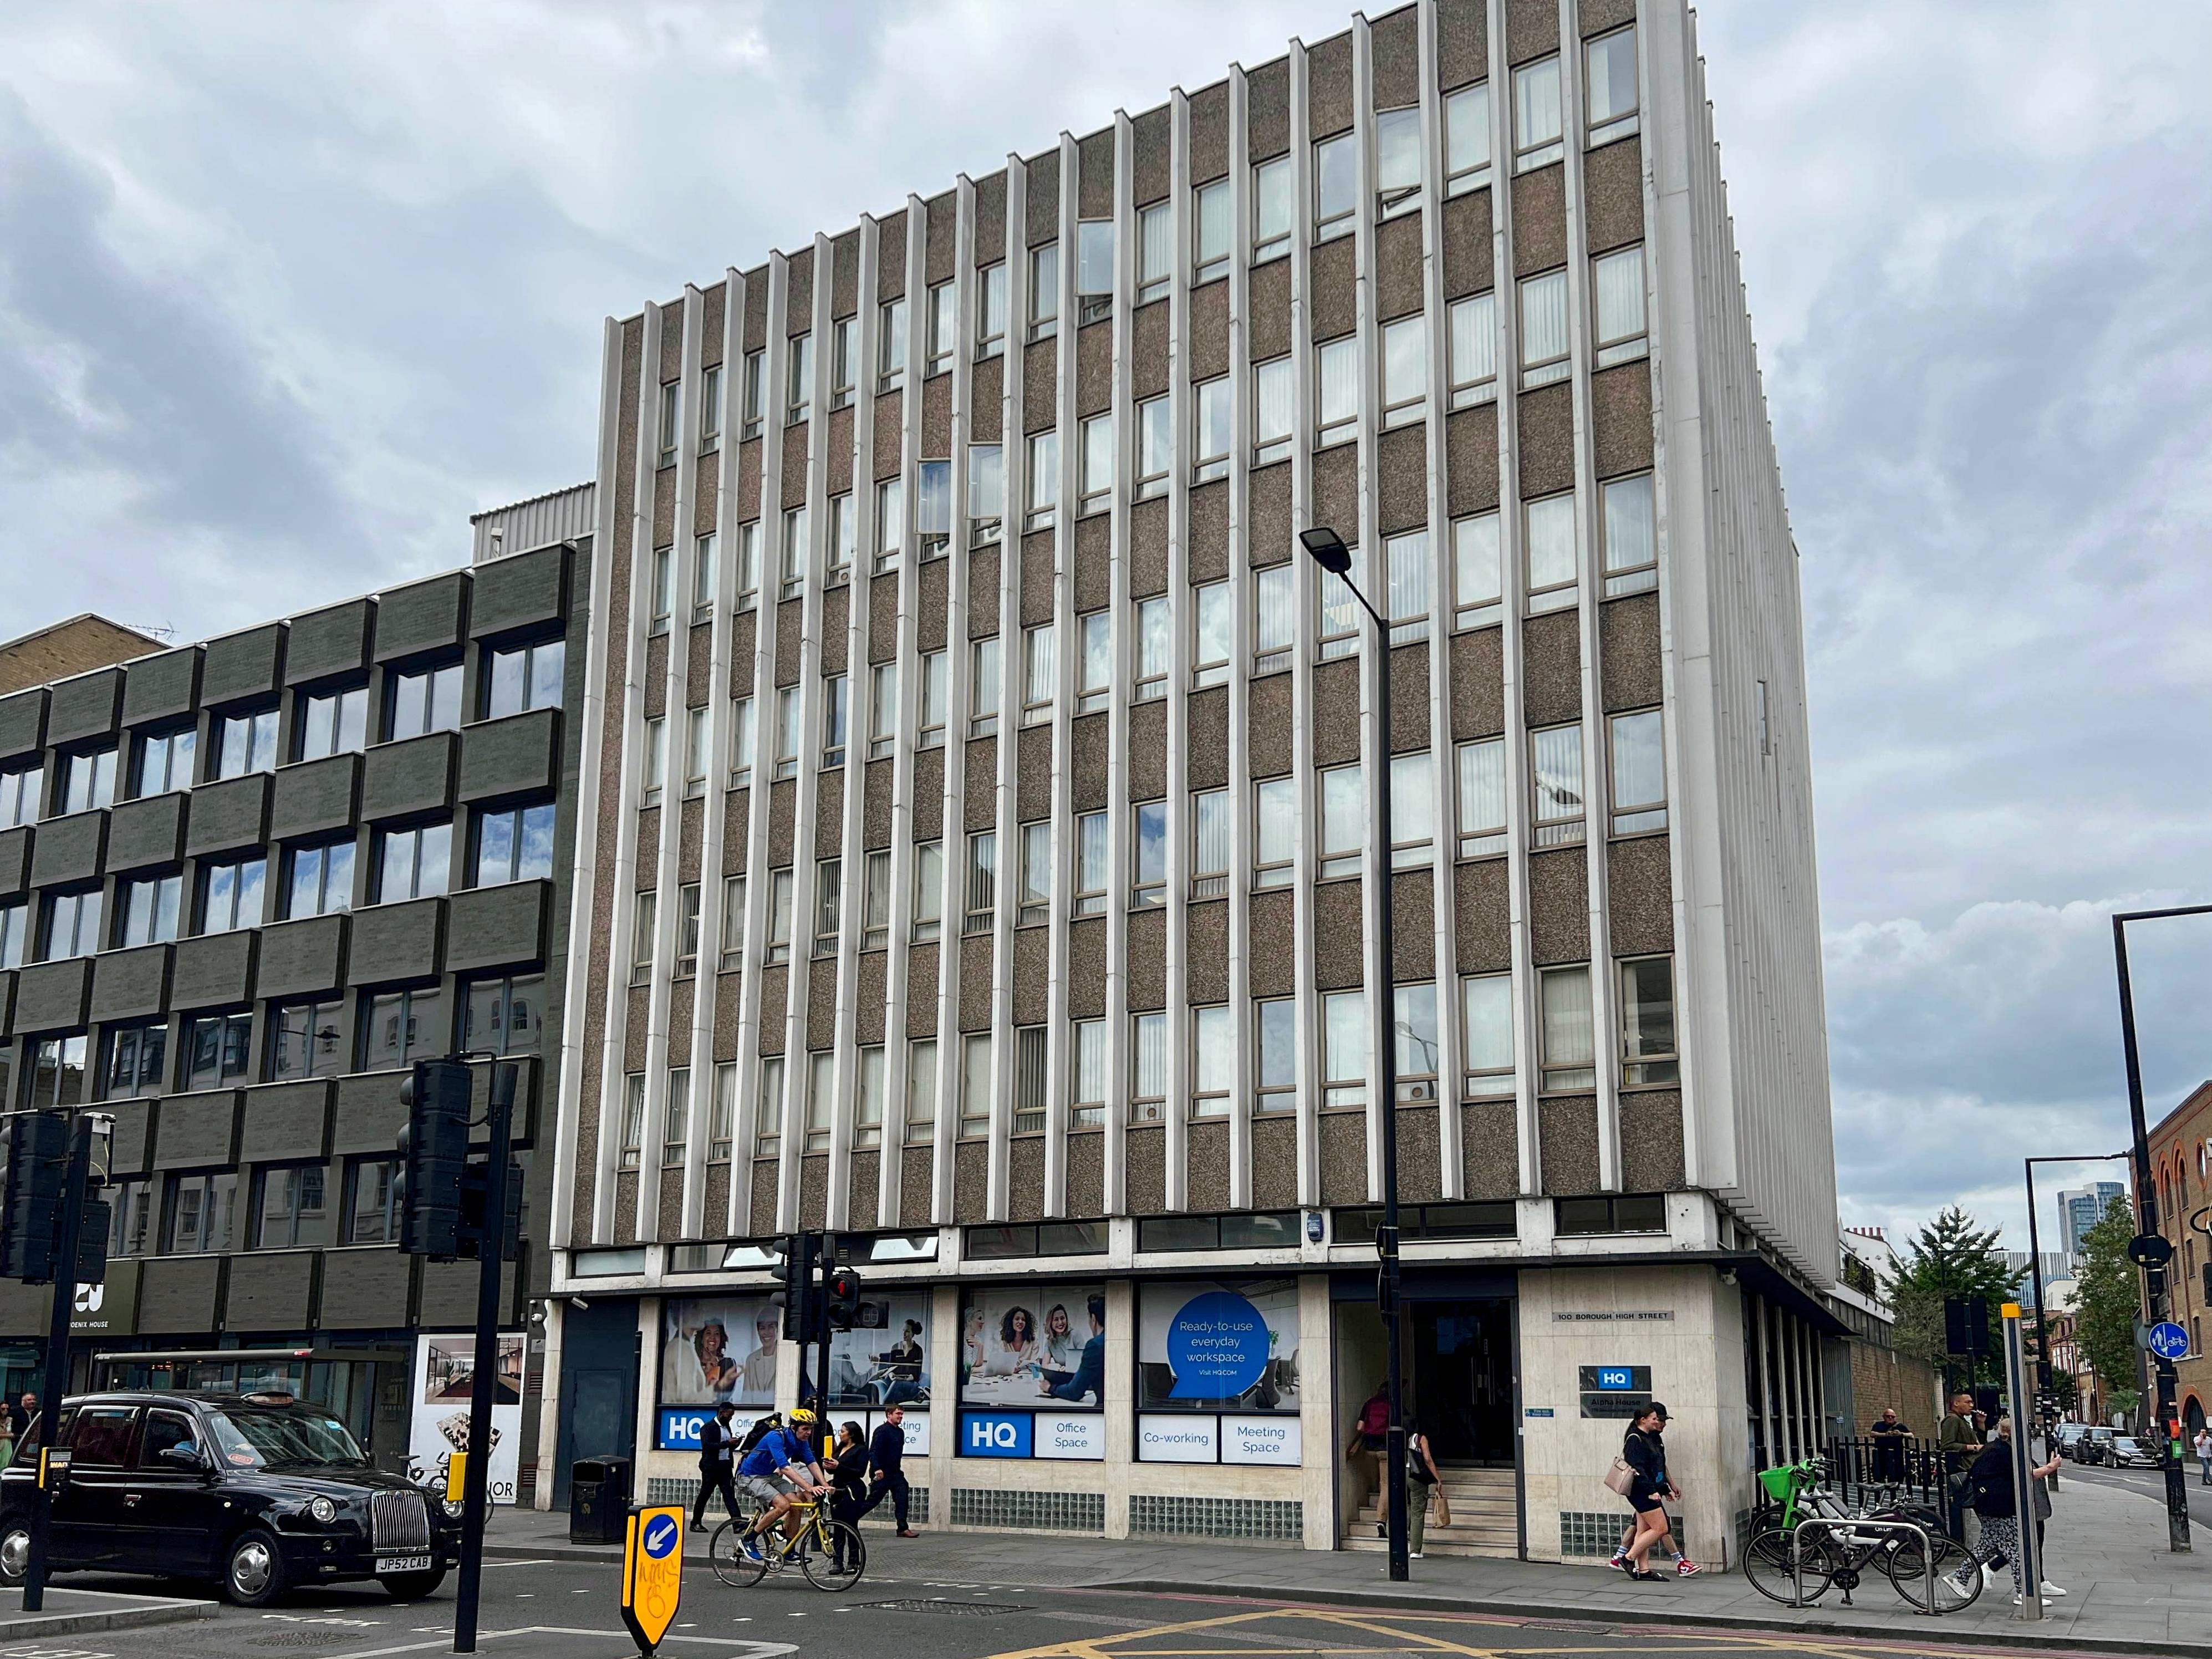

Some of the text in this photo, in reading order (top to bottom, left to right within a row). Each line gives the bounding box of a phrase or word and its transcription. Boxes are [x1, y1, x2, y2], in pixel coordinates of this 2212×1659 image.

[1180, 1321, 1253, 1334] Ready-to-use
[1191, 1336, 1241, 1348] everyday
[1186, 1352, 1246, 1364] workspace
[1603, 1373, 1626, 1384] HQ
[1591, 1398, 1614, 1407] Alpha
[736, 1419, 755, 1428] Offic
[899, 1422, 921, 1432] eting
[1056, 1422, 1087, 1433] Office
[972, 1422, 1017, 1448] HQ
[1144, 1432, 1209, 1446] Co-working
[1237, 1426, 1285, 1440] Meeting
[1054, 1437, 1088, 1449] Space
[1242, 1442, 1281, 1454] Space
[380, 1557, 428, 1570] JP52 CAB
